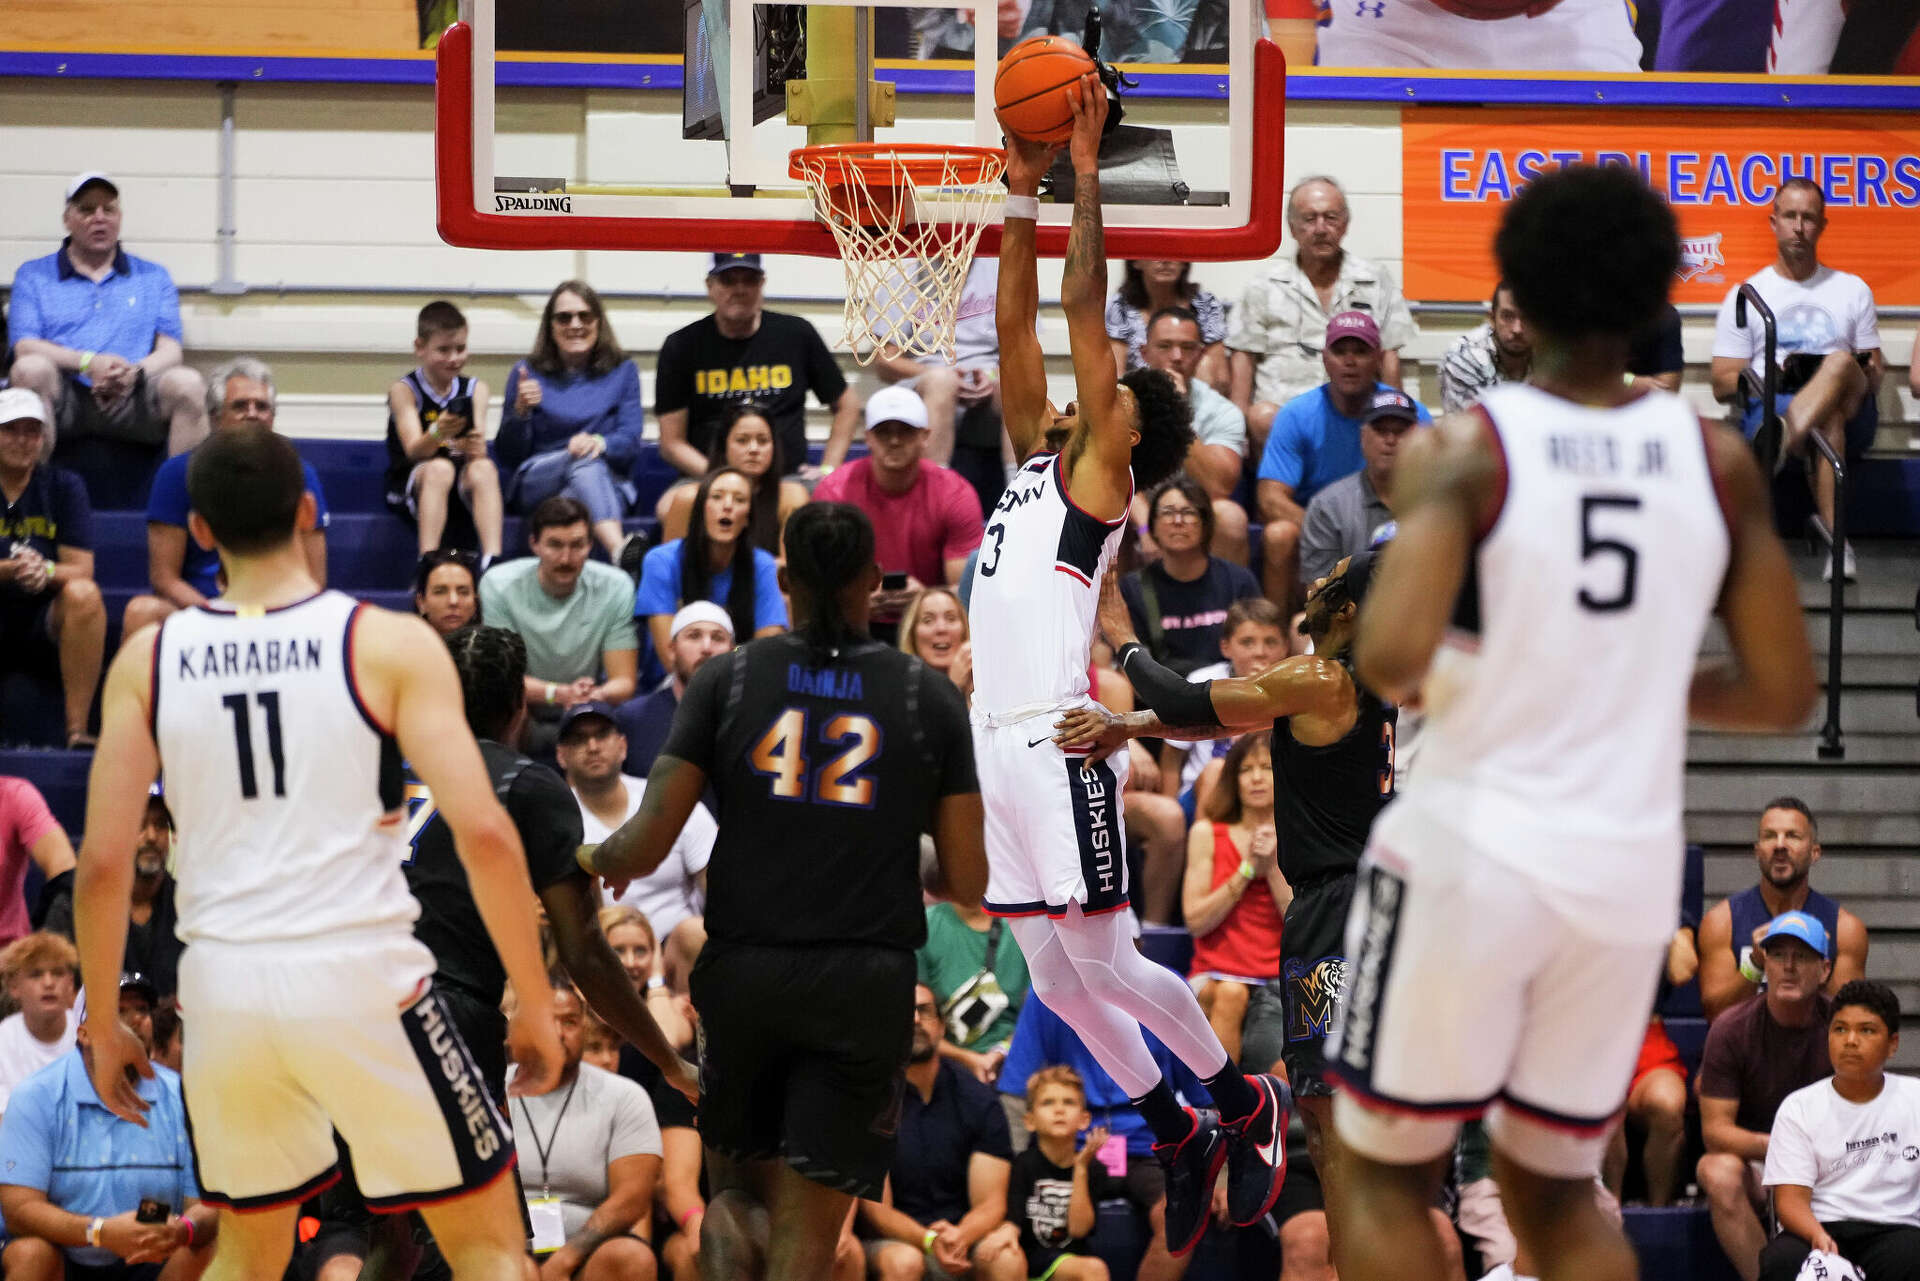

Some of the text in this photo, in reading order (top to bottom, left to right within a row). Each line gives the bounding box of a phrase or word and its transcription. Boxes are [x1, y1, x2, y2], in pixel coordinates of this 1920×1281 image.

[495, 195, 571, 213] SPALDING
[1680, 242, 1712, 255] AUI
[696, 364, 793, 395] IDAHO
[981, 523, 1005, 577] 3
[1577, 494, 1642, 614] 5
[179, 639, 322, 681] KARABAN
[787, 663, 864, 700] DAINJA
[222, 691, 287, 800] 11
[747, 706, 882, 809] 42
[1079, 765, 1114, 893] HUSKIES
[415, 996, 501, 1162] HUSKIES
